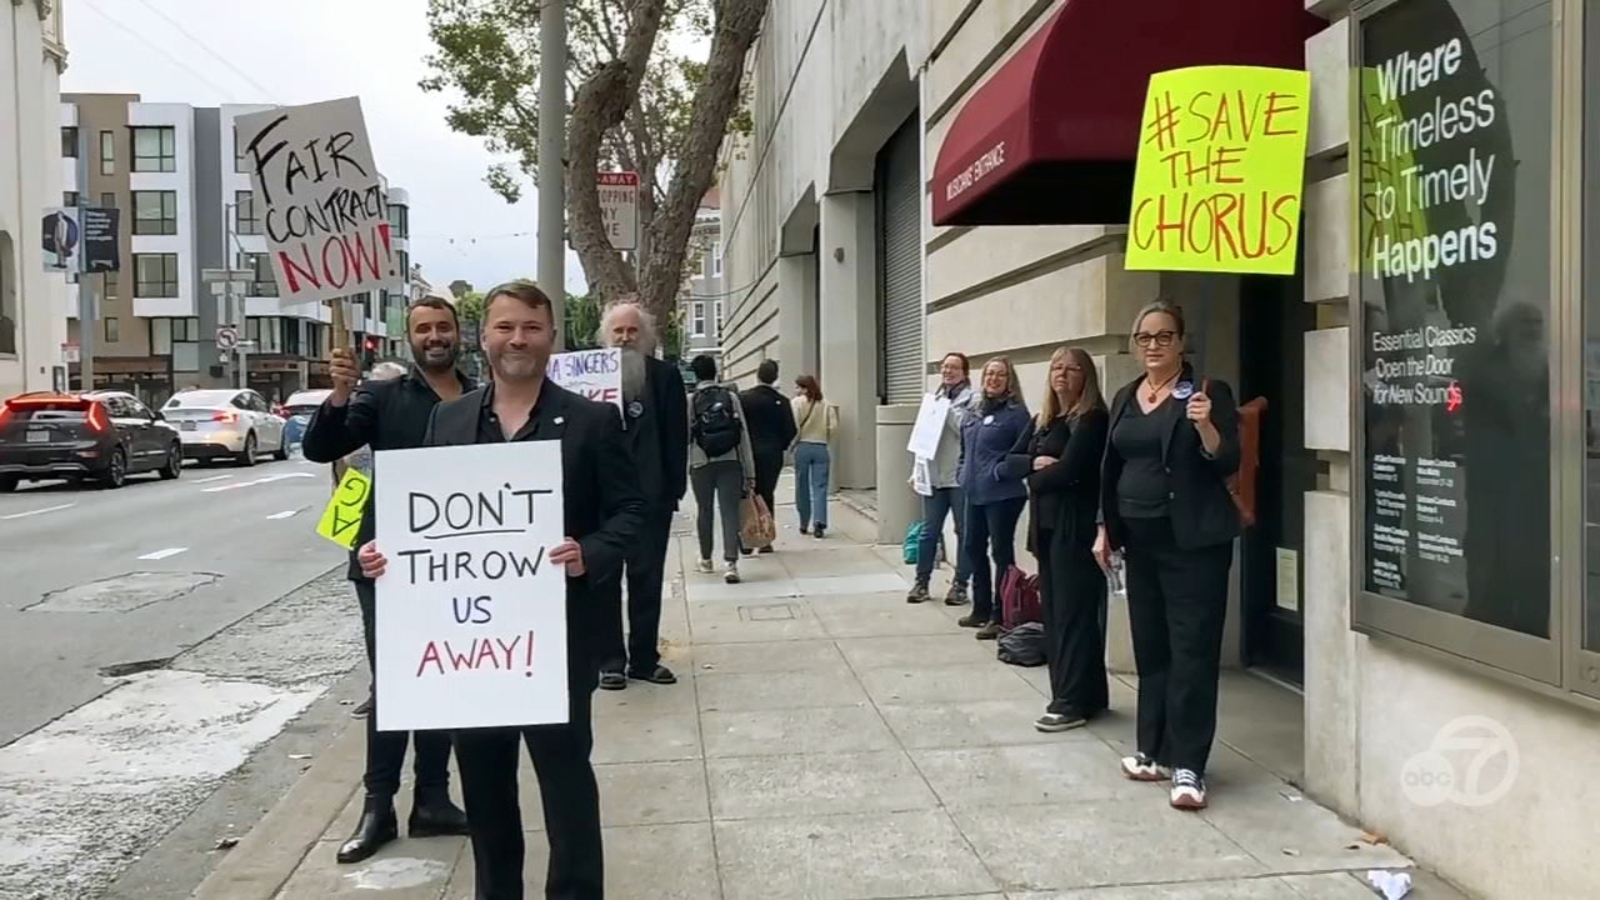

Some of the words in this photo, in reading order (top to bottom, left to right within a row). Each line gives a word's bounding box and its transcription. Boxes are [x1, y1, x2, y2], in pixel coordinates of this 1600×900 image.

[1376, 37, 1462, 106] Where
[1145, 89, 1300, 151] #SAVE
[1375, 89, 1496, 162] Timeless
[245, 115, 368, 206] FAIR
[1159, 145, 1248, 189] THE
[1375, 181, 1396, 221] to
[1400, 148, 1496, 213] Timely
[266, 184, 382, 244] CONTRACT
[1133, 190, 1298, 262] CHORUS
[278, 223, 396, 293] NOW!
[1372, 221, 1498, 284] Happens
[563, 350, 619, 377] SINGERS
[1373, 328, 1424, 352] Essential
[1424, 325, 1477, 347] Classics
[1374, 383, 1388, 404] for
[1388, 384, 1413, 404] New
[1375, 357, 1405, 382] Open
[1406, 355, 1425, 376] the
[1425, 354, 1454, 375] Door
[408, 482, 553, 533] DON'T
[397, 546, 545, 585] THROW
[453, 595, 492, 624] US
[416, 630, 534, 678] AWAY!
